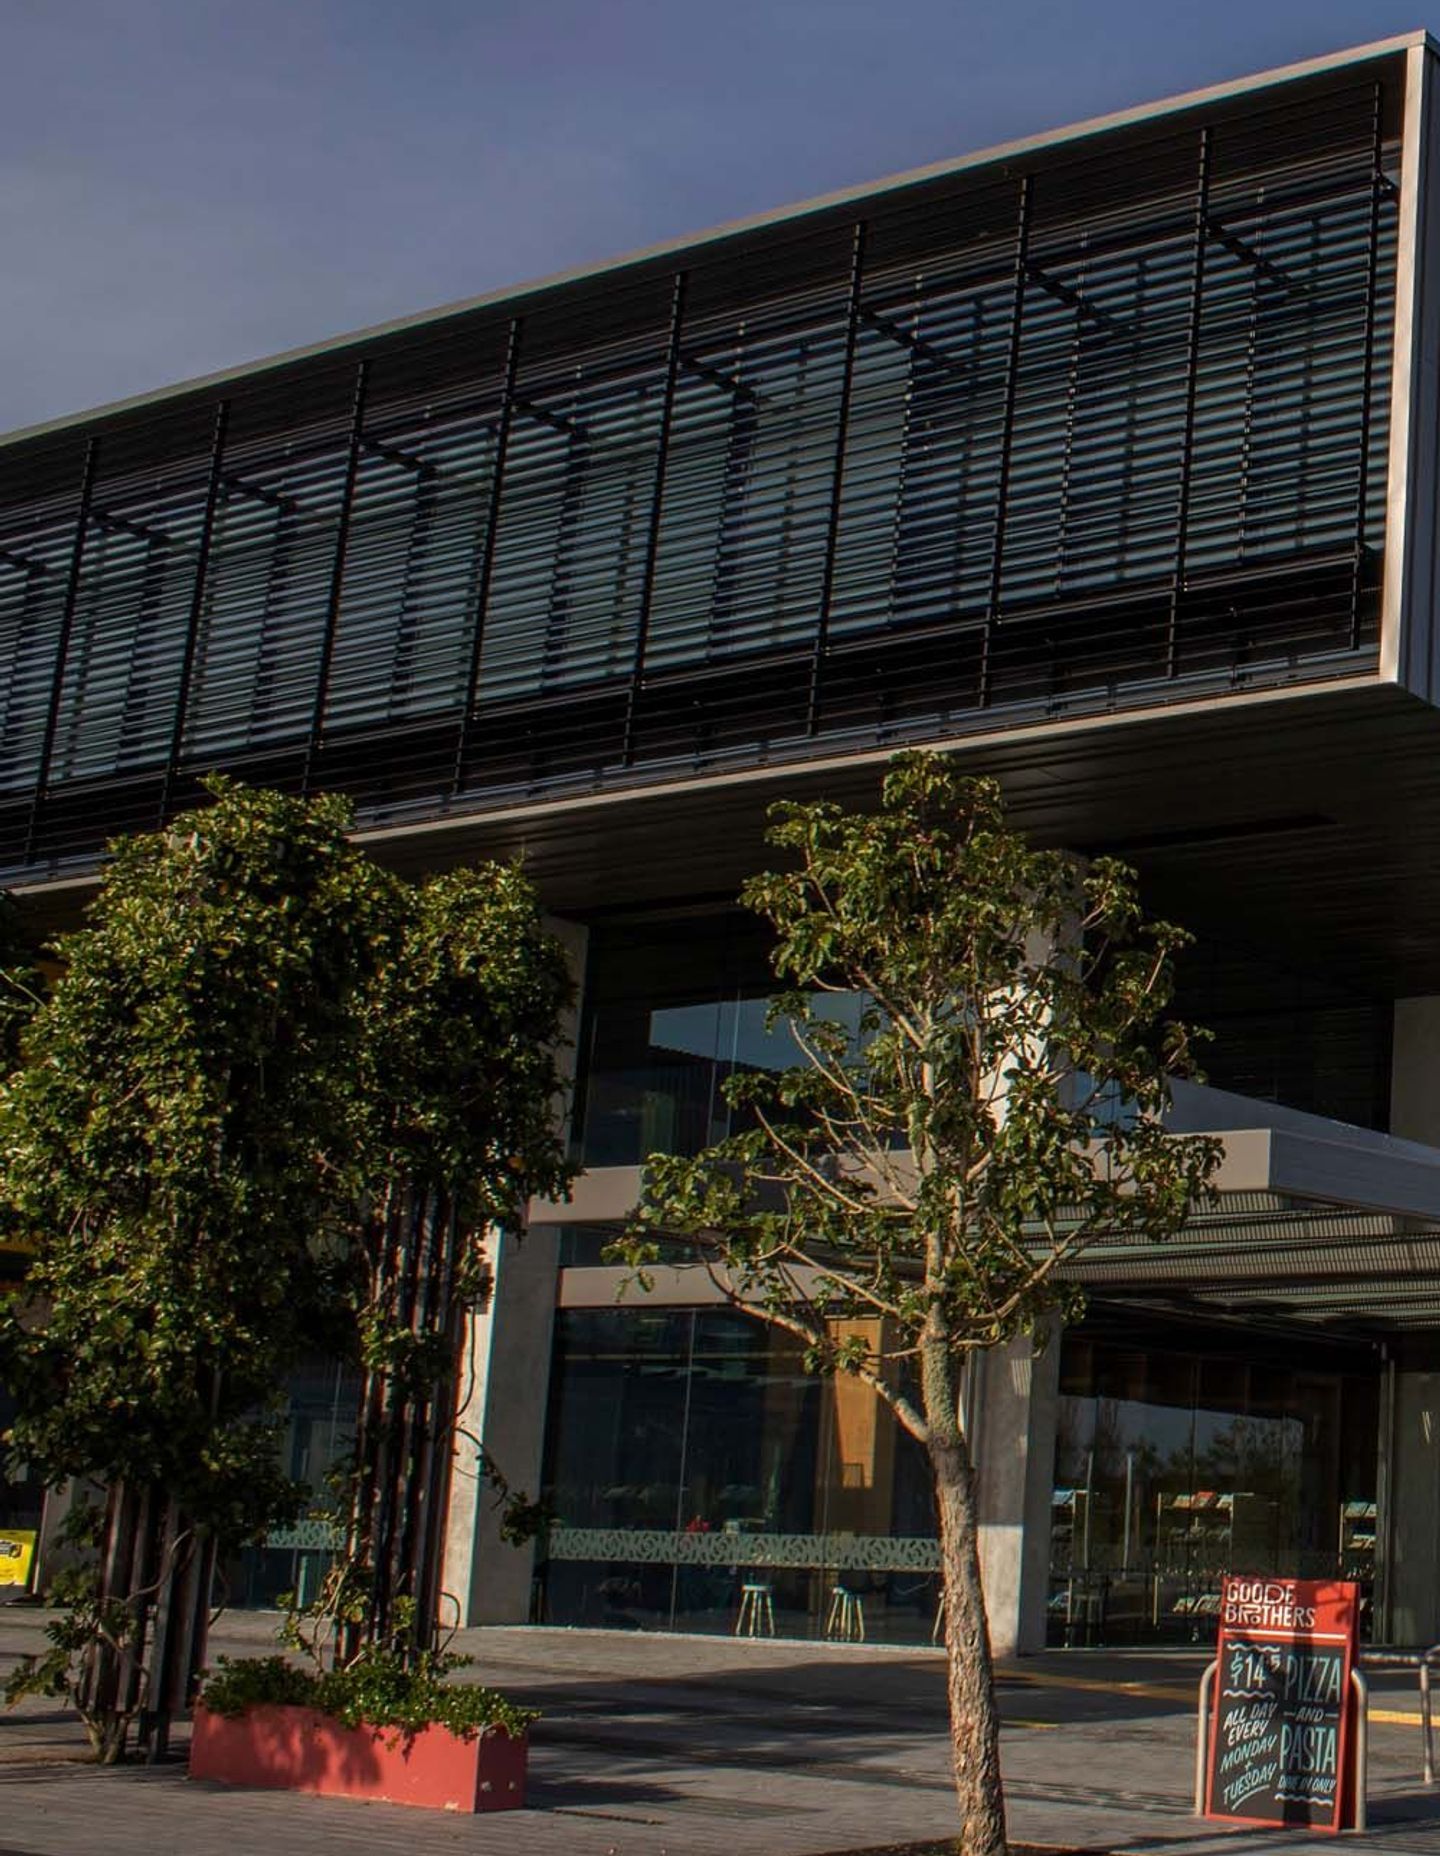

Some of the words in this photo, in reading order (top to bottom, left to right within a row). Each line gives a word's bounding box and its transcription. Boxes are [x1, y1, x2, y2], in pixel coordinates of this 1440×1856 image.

[1227, 1582, 1295, 1605] GOODE
[1225, 1603, 1315, 1627] BROTHERS
[1284, 1655, 1341, 1703] PIZZA
[1223, 1707, 1246, 1731] ALL
[1250, 1702, 1278, 1720] DAY
[1295, 1707, 1325, 1723] AND
[1228, 1719, 1269, 1746] EVERY
[1220, 1734, 1278, 1774] MONDAY
[1279, 1724, 1336, 1774] PASTA
[1223, 1762, 1278, 1805] TUESDAY
